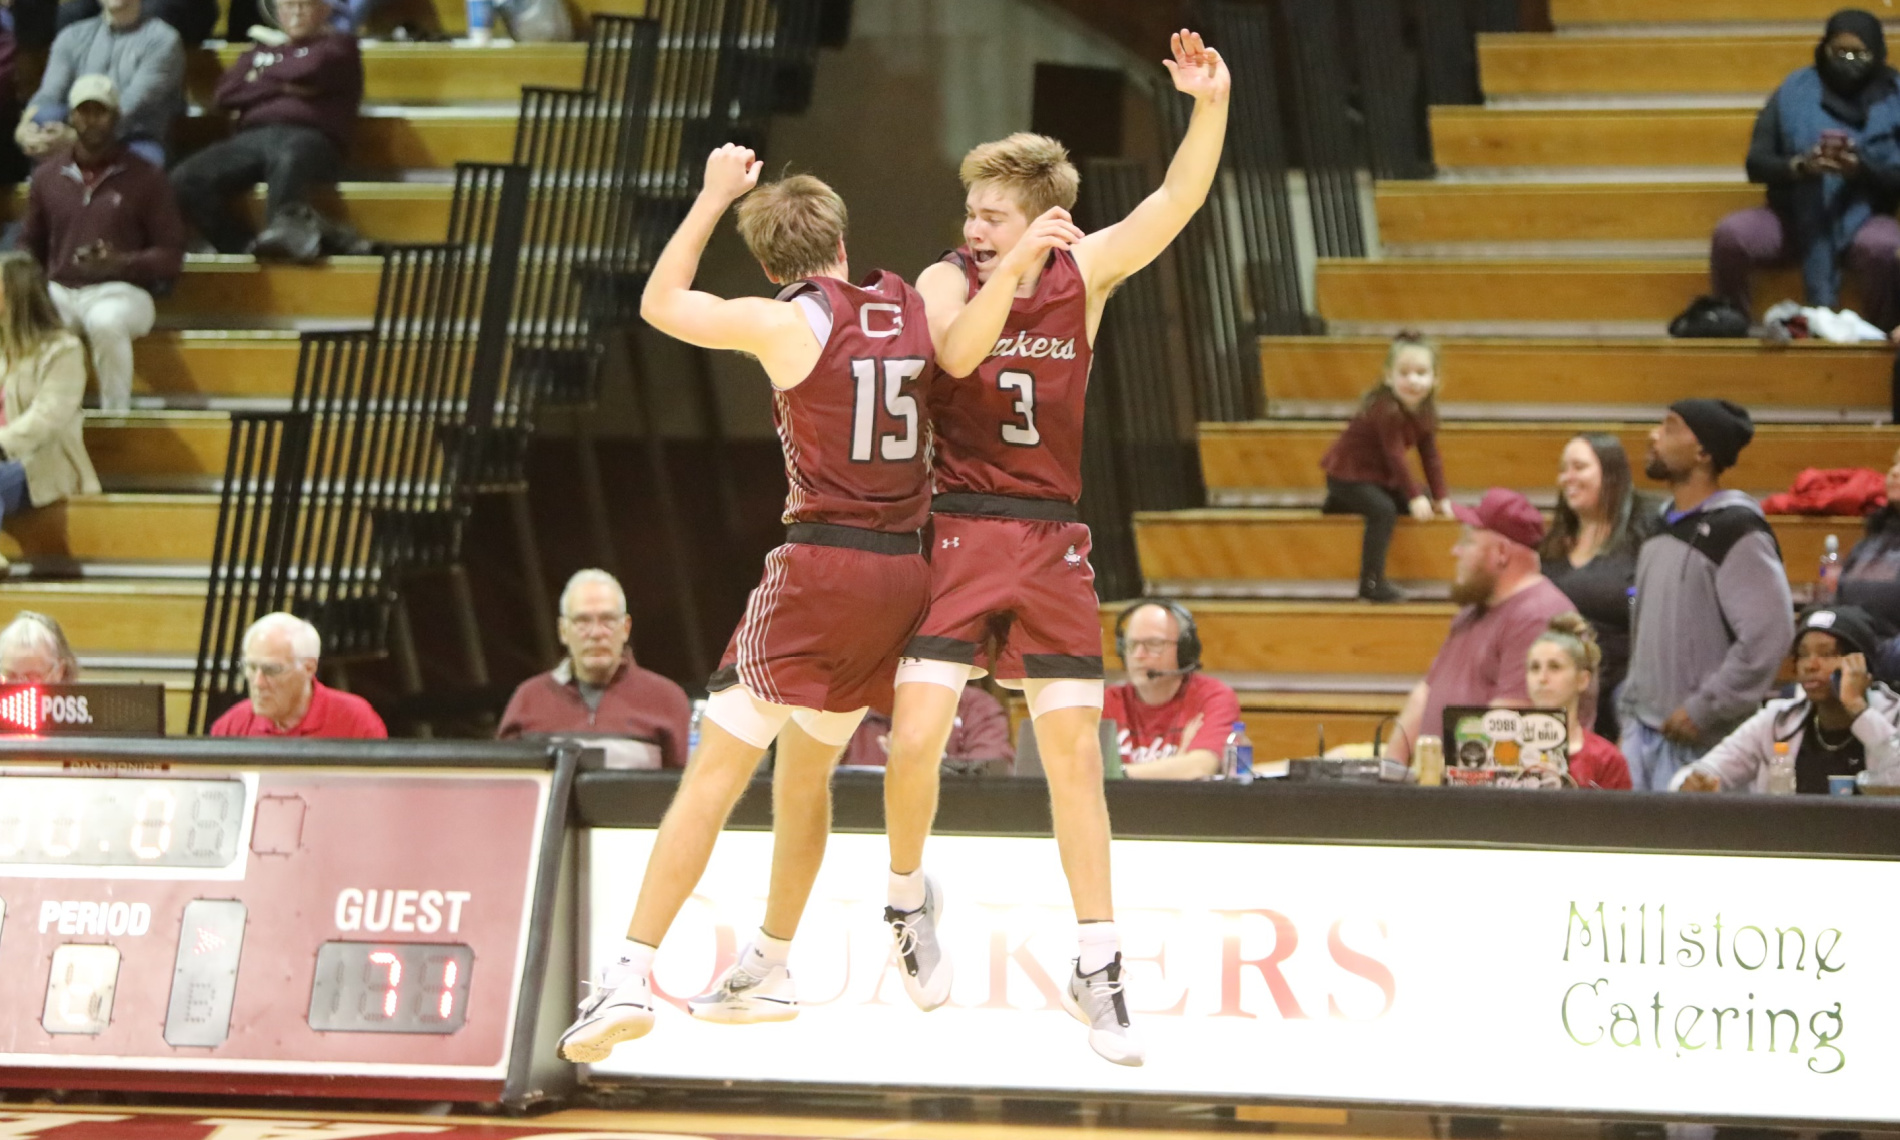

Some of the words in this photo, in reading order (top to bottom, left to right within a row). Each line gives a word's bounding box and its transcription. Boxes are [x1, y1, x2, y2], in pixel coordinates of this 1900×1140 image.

[984, 330, 1077, 360] akers
[850, 355, 927, 464] 15
[997, 369, 1041, 448] 3
[41, 695, 93, 725] POSS.
[38, 900, 151, 936] PERIOD
[335, 888, 471, 934] GUEST
[1562, 900, 1847, 980] Millstone
[368, 951, 457, 1020] 71
[1560, 977, 1847, 1075] Catering
